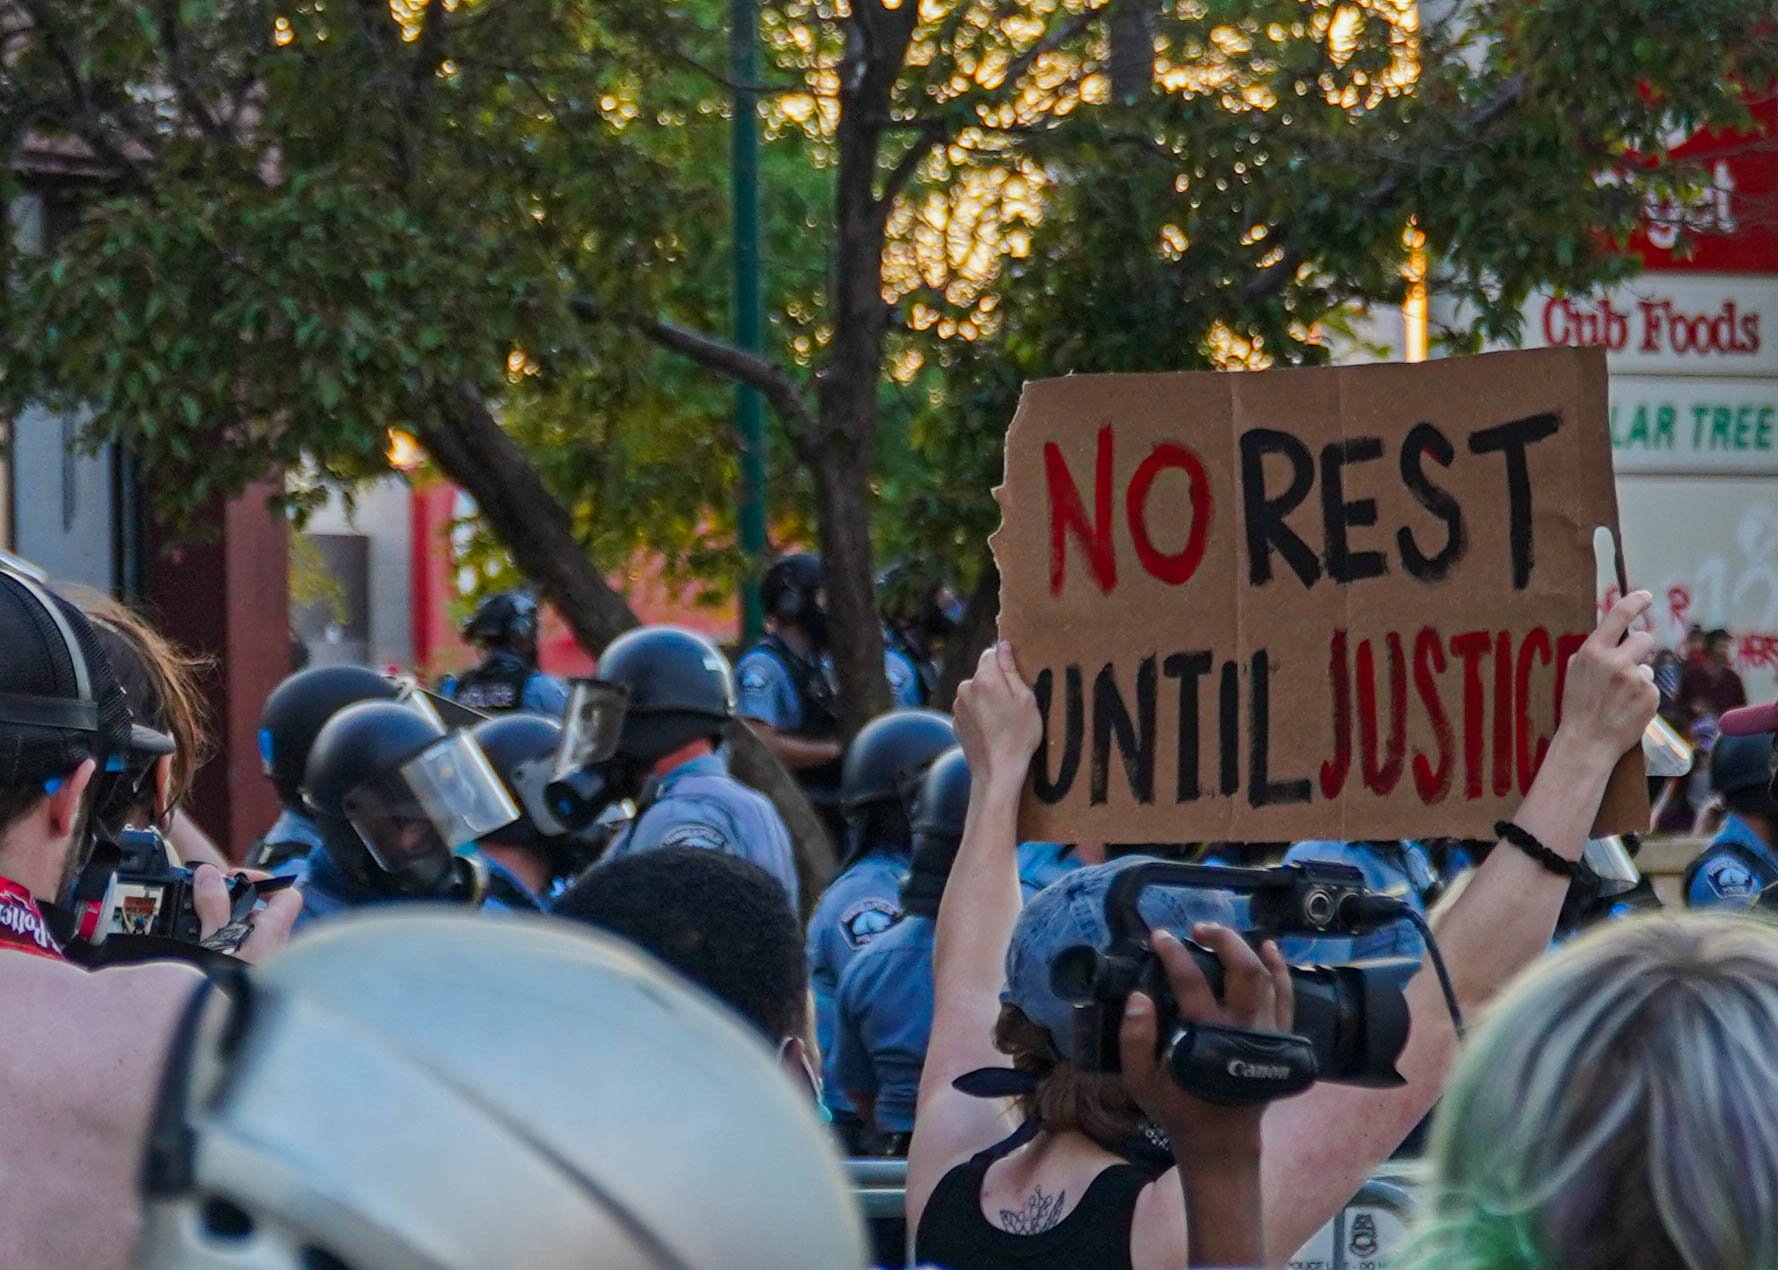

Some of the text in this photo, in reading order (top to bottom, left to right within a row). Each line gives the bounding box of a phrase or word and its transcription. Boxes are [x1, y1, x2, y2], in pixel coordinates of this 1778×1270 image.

[1542, 298, 1760, 354] Cub Foods
[1611, 405, 1774, 451] LAR TREE
[1044, 423, 1213, 596] NO
[1239, 411, 1564, 590] REST
[1034, 650, 1311, 808] UNTIL
